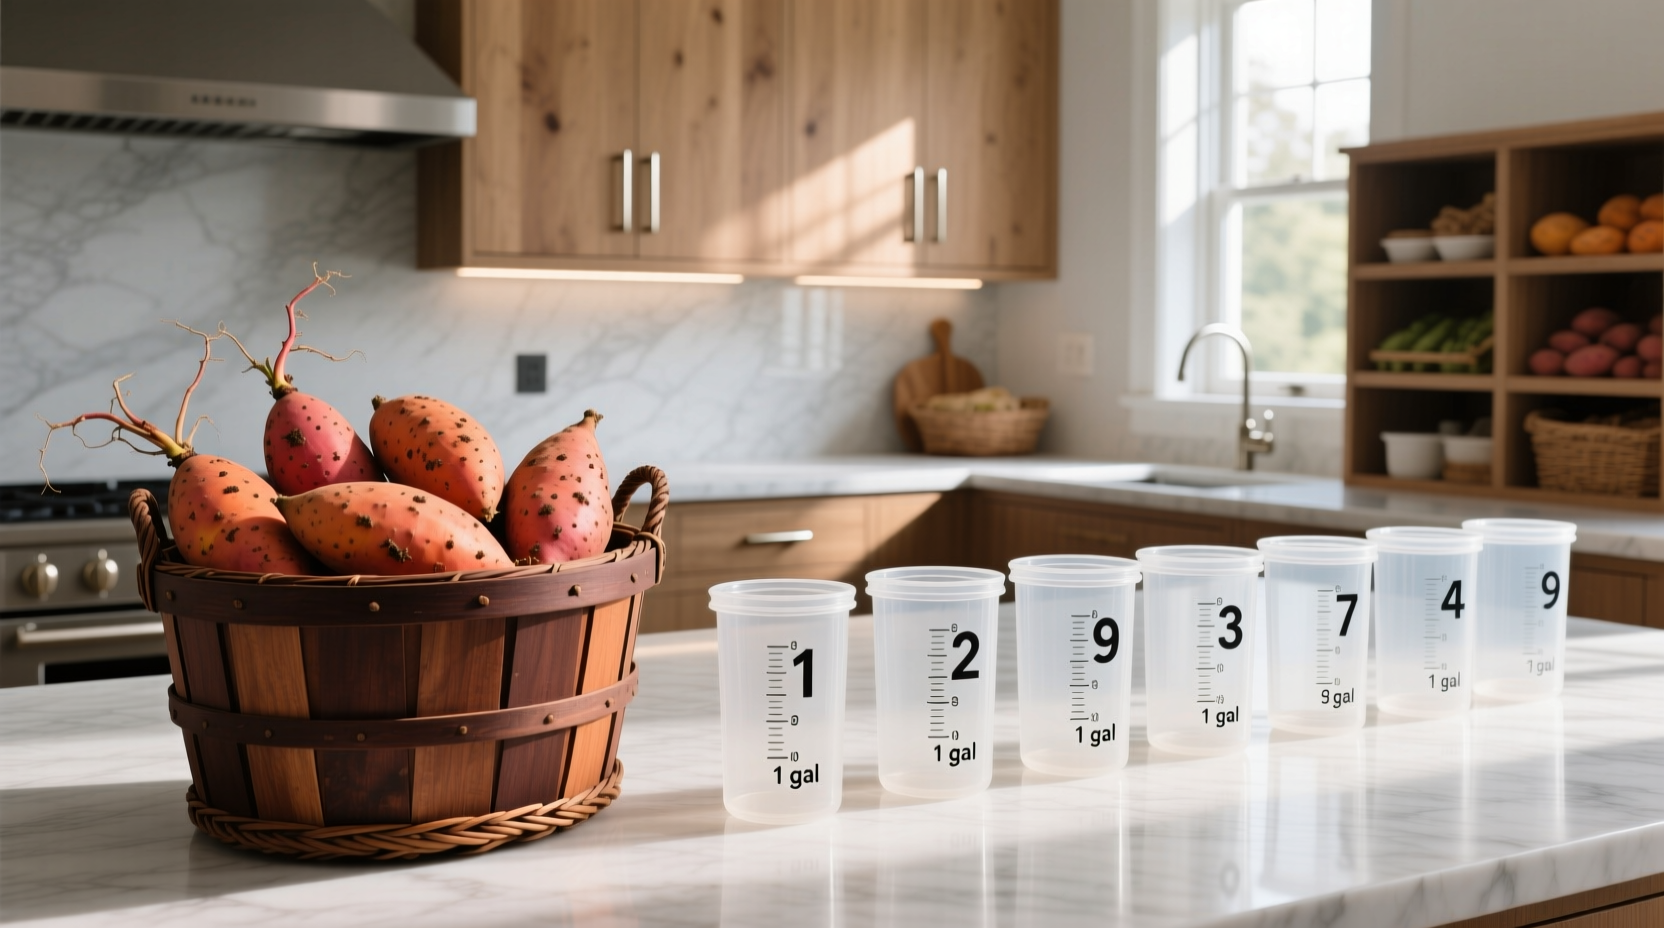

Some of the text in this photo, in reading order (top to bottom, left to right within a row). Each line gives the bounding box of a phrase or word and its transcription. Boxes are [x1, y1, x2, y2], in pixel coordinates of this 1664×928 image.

[1440, 579, 1465, 619] 4
[1541, 570, 1560, 609] 9
[1218, 604, 1243, 650] 3
[1336, 593, 1358, 636] 7
[951, 630, 980, 680] 2
[1092, 617, 1120, 663] 9
[792, 648, 813, 698] 1
[1428, 671, 1461, 692] 1 gal
[1537, 657, 1555, 676] gal
[1332, 687, 1355, 709] gal
[1202, 705, 1239, 728] 1 gal
[1075, 723, 1116, 747] 1 gal
[933, 741, 976, 767] 1 gal
[773, 763, 819, 789] 1 gal
